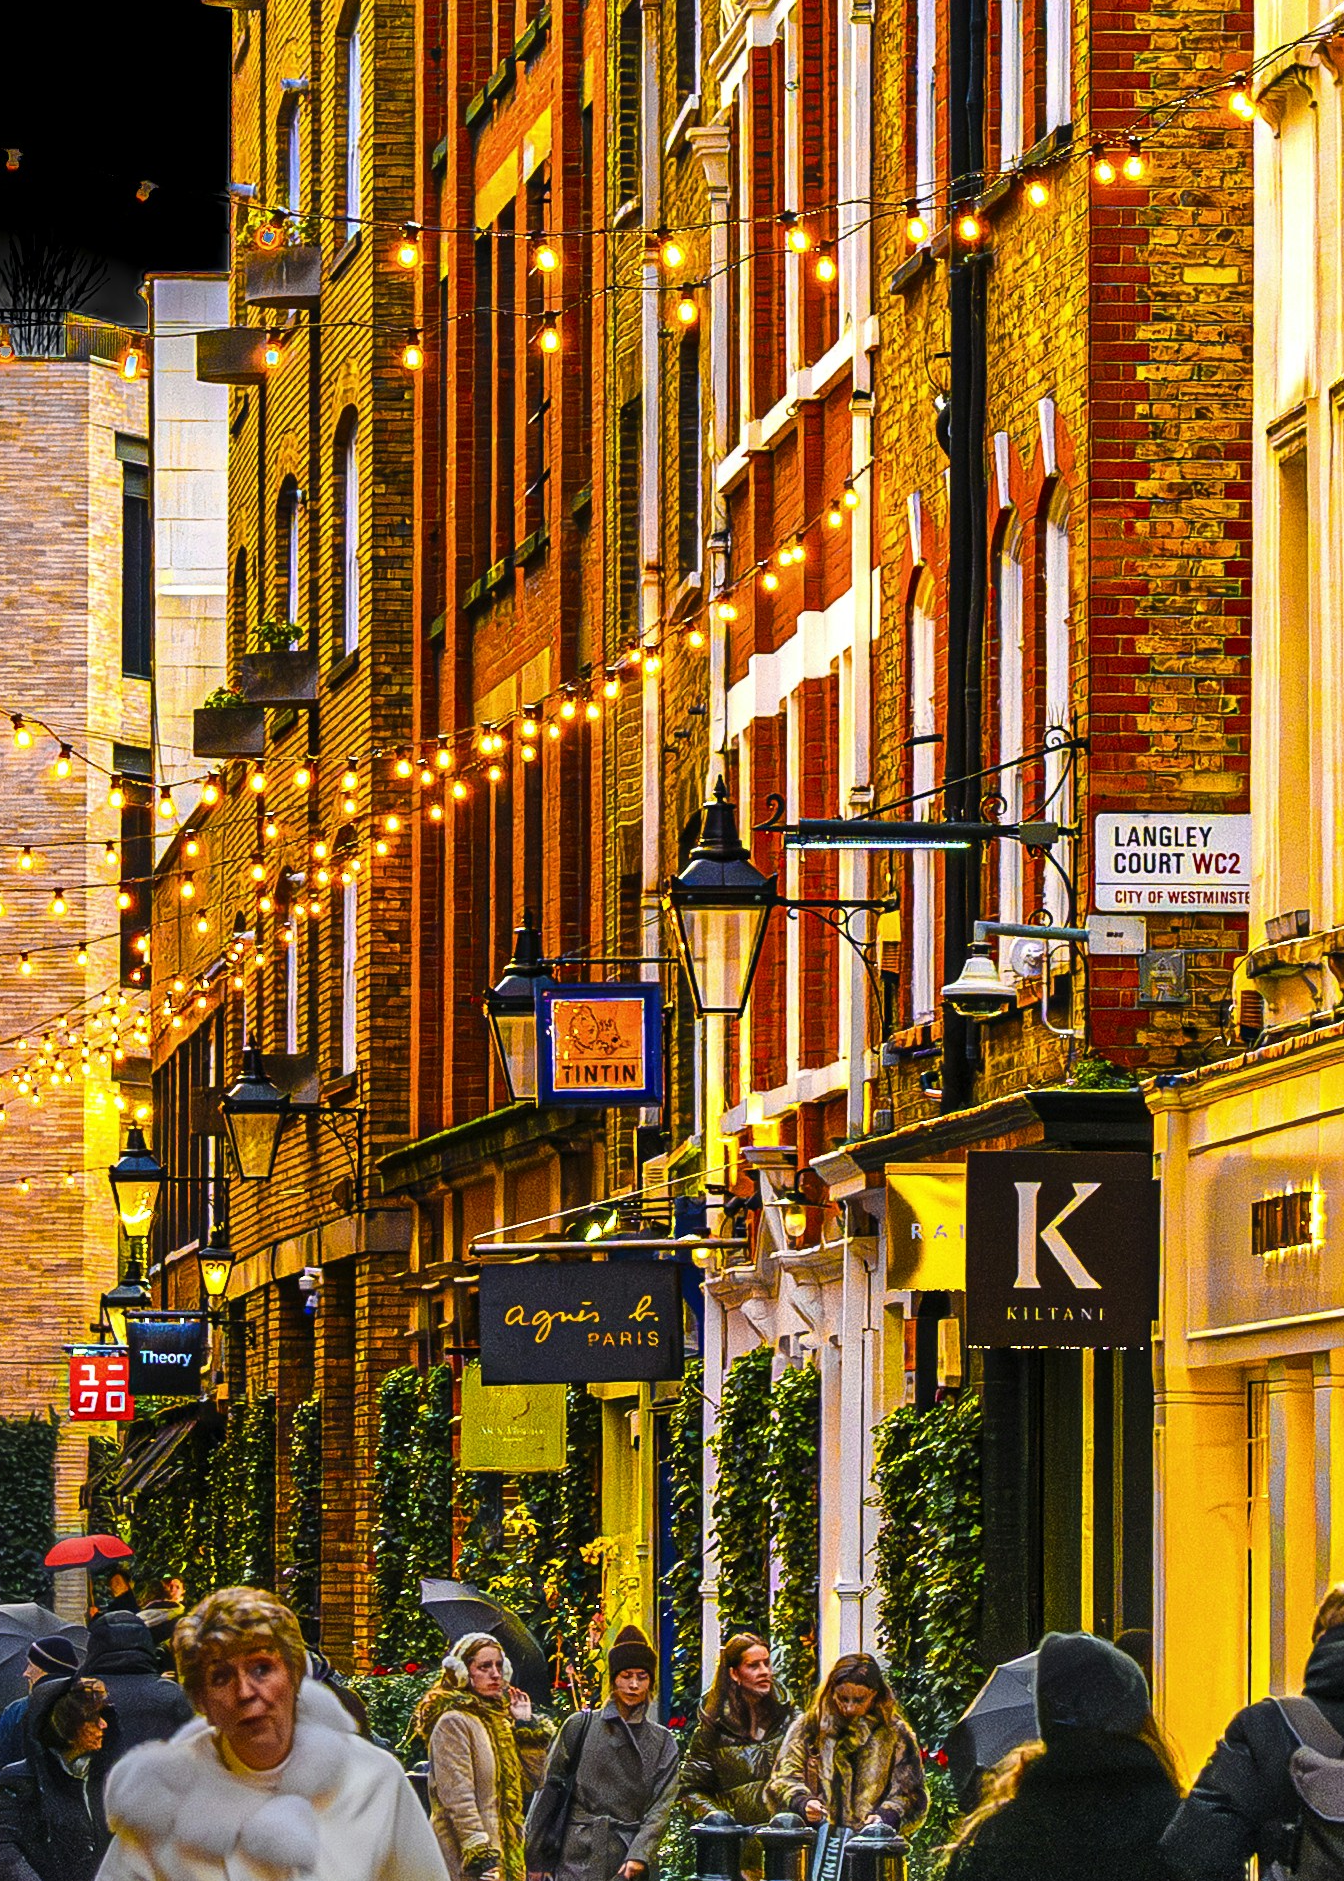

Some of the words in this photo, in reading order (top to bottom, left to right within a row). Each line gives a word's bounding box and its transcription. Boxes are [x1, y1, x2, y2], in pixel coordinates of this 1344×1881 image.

[1113, 826, 1213, 848] LANGLEY
[1113, 852, 1186, 875] COURT
[1192, 852, 1242, 875] WC2
[1114, 890, 1143, 904] CITY
[1147, 890, 1164, 904] OF
[561, 1064, 637, 1085] TINTIN
[1012, 1181, 1103, 1290] K
[504, 1301, 601, 1344] agnès
[628, 1294, 660, 1322] b.
[586, 1330, 660, 1348] PARIS
[139, 1350, 193, 1367] Theory
